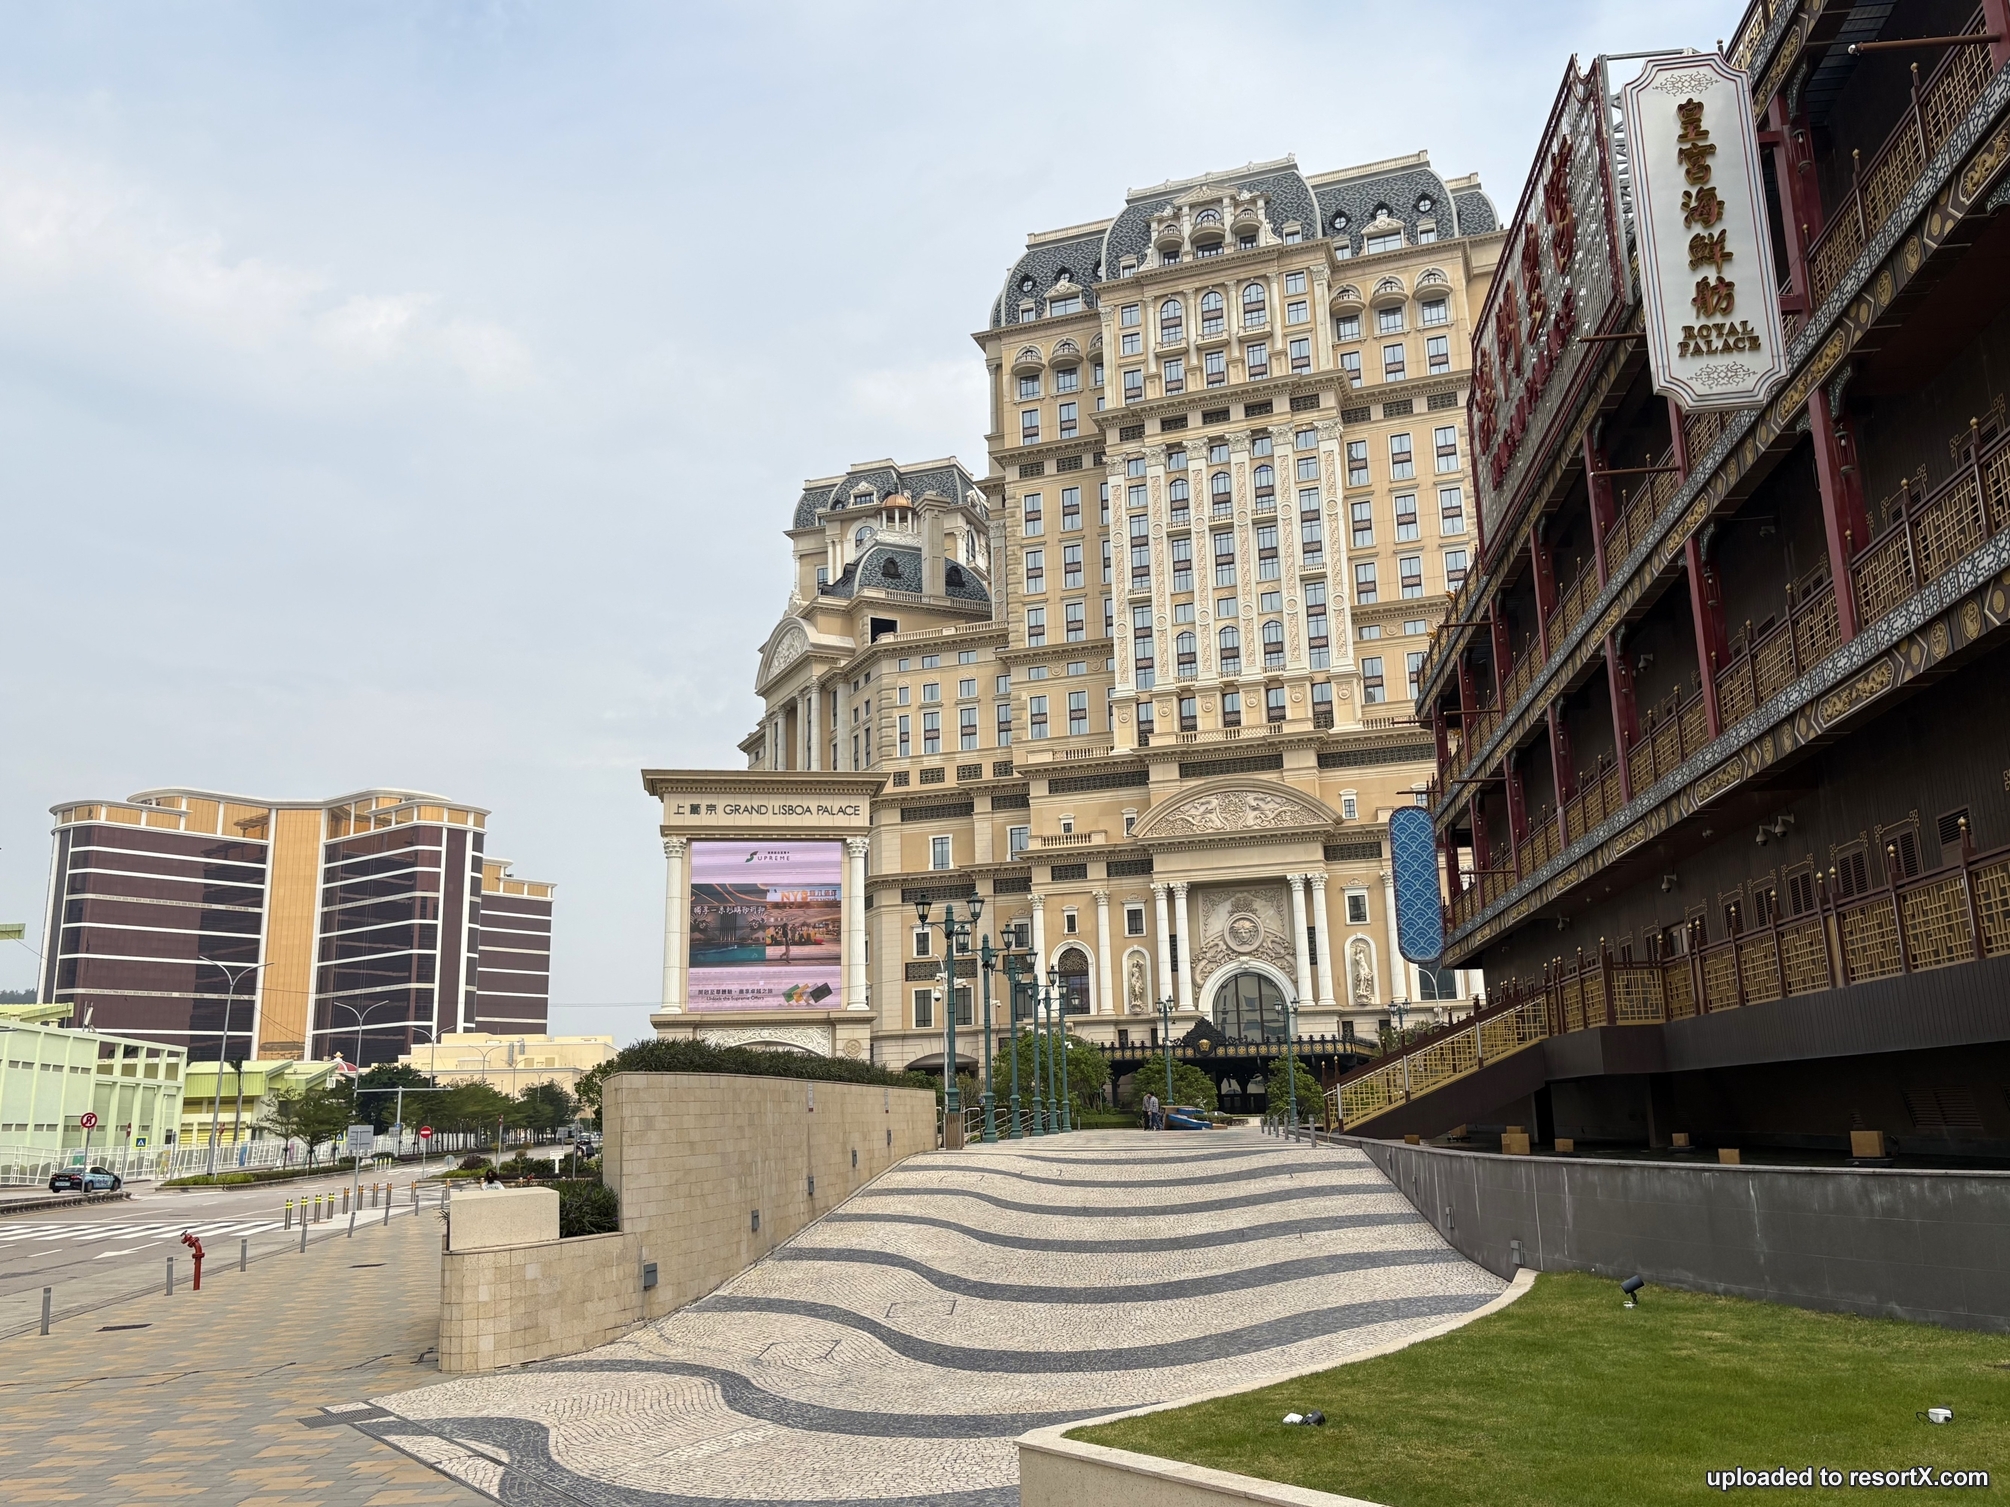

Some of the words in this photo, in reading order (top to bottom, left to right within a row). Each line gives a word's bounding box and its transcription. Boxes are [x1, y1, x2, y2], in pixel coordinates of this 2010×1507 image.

[1676, 98, 1735, 319] 皇宮海鮮舫
[1681, 320, 1754, 340] ROYAL
[1677, 335, 1761, 357] PALACE
[673, 803, 717, 815] 上葡京
[723, 804, 768, 815] GRAND
[772, 804, 813, 816] LISBOA
[817, 804, 860, 816] PALACE
